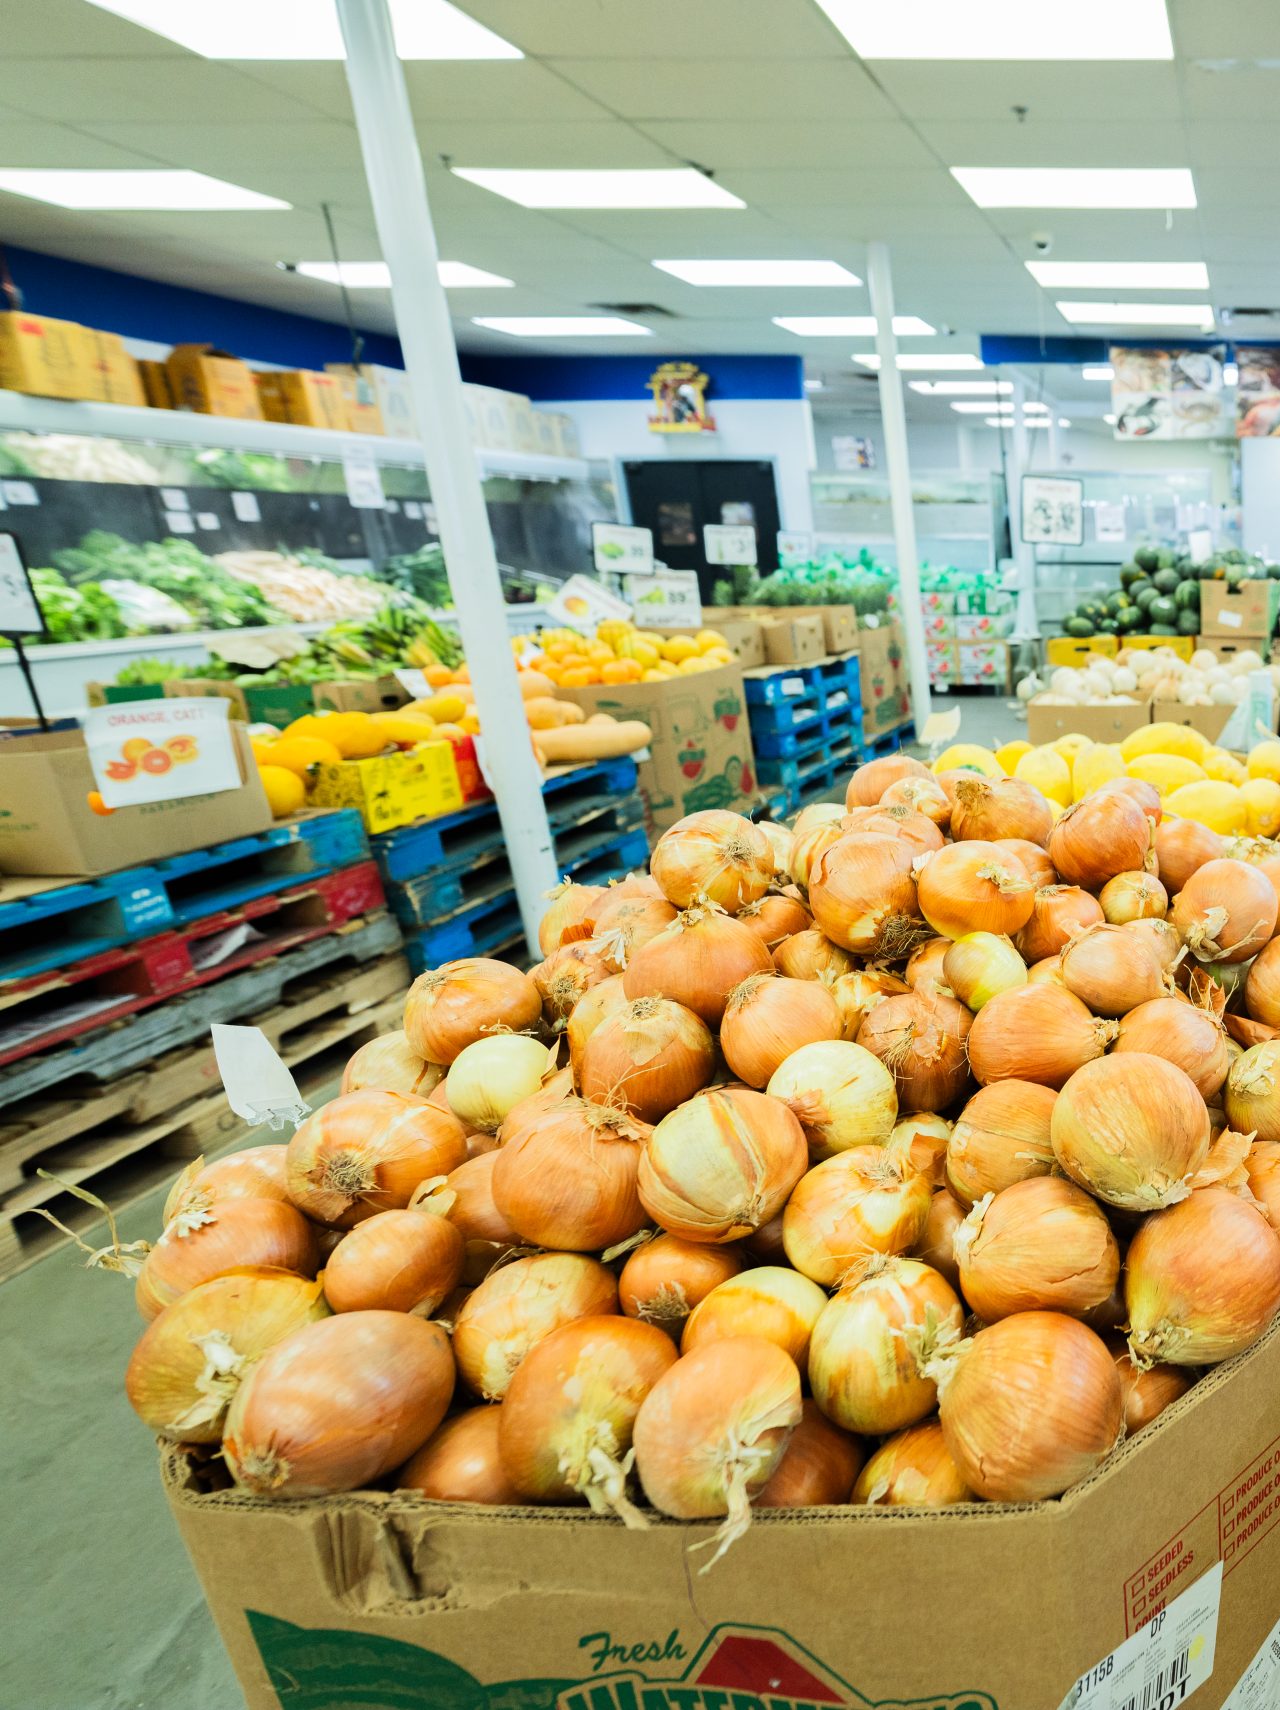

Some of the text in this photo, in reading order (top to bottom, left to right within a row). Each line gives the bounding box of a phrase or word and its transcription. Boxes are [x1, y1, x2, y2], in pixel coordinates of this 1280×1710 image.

[1235, 1460, 1273, 1503] PRODUCE
[1236, 1484, 1273, 1526] PRODUCE
[1236, 1506, 1273, 1548] PRODUCE
[1147, 1540, 1183, 1583] SEEDED
[1148, 1550, 1194, 1604] SEEDLESS
[1151, 1610, 1167, 1638] DP
[578, 1628, 687, 1671] Fresh
